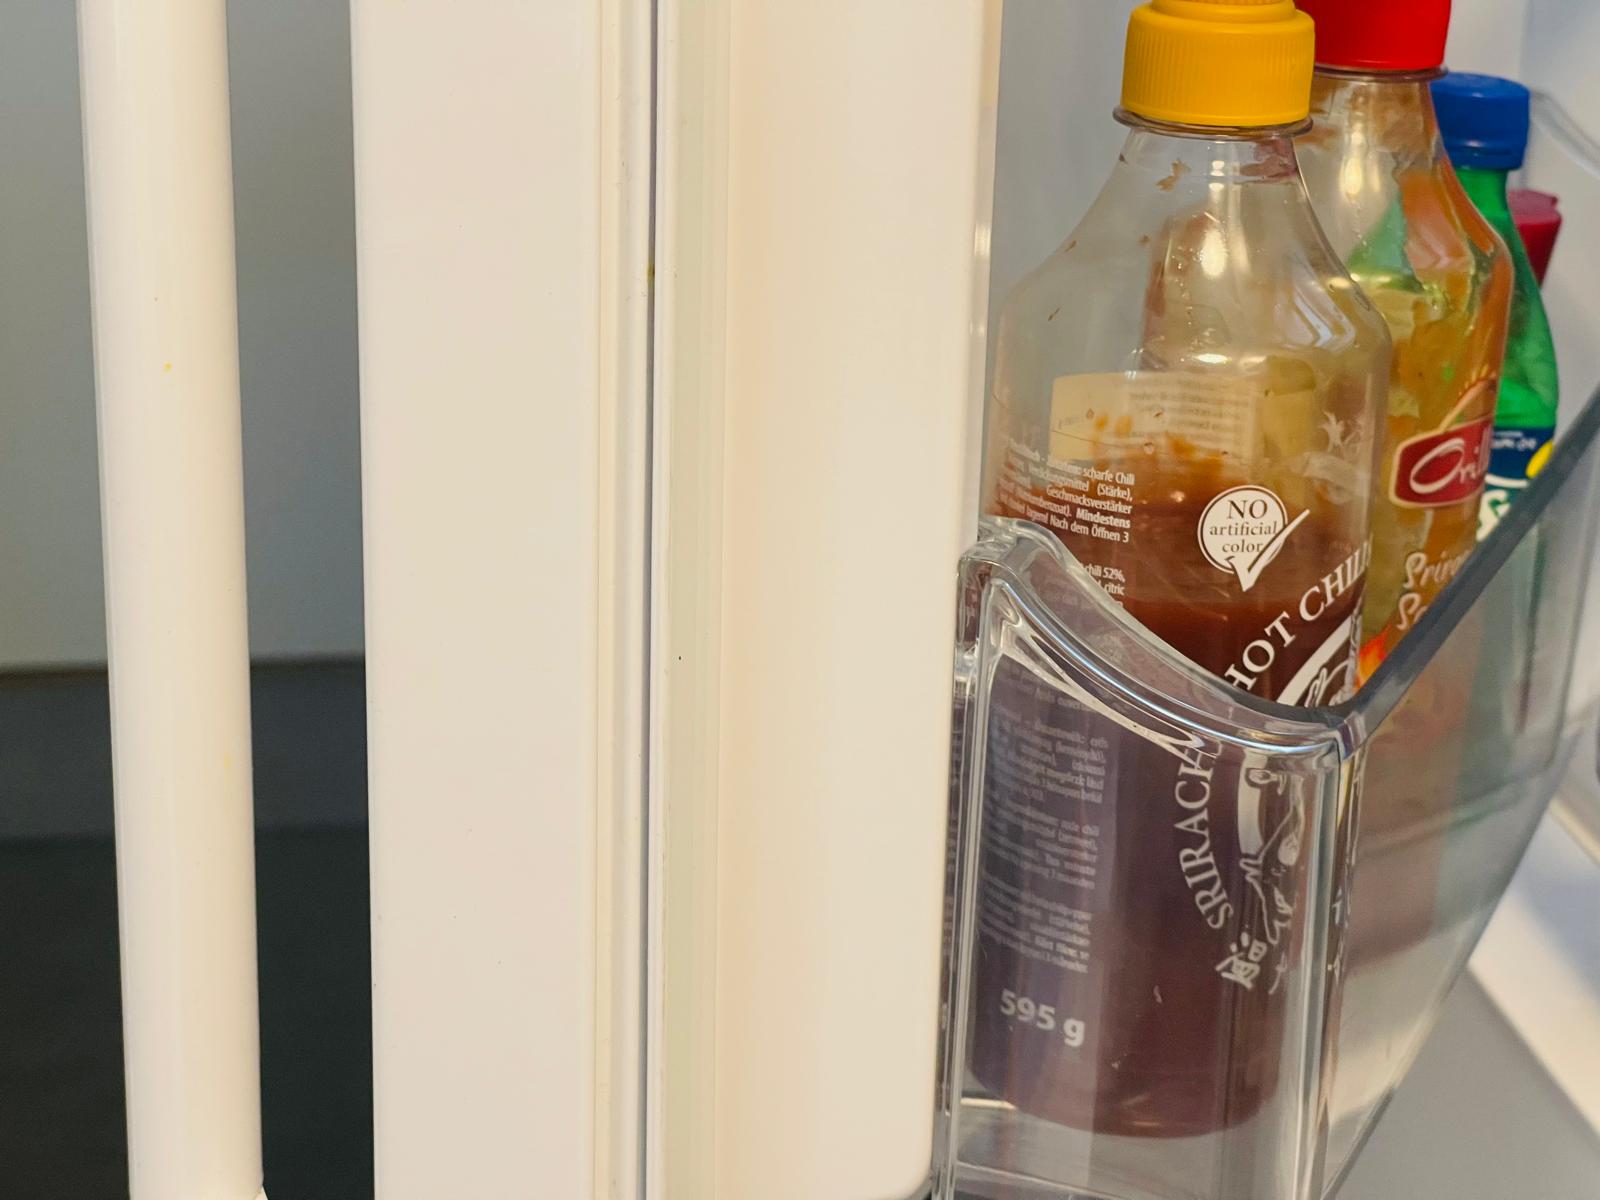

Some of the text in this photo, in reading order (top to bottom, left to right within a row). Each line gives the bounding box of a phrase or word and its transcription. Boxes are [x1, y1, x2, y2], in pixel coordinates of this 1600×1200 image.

[1083, 467, 1113, 482] scharfe
[1046, 485, 1133, 514] Geschmacksverstärker
[1097, 483, 1133, 502] (Stärke),
[1076, 507, 1131, 529] Mindestens
[1227, 499, 1268, 519] NO
[1050, 515, 1069, 530] Nach
[1070, 521, 1089, 535] dem
[1091, 524, 1120, 542] Öffnen
[1122, 531, 1130, 543] 3
[1209, 521, 1278, 536] artificial
[1222, 539, 1264, 553] color
[1224, 611, 1296, 692] HOT
[1000, 987, 1086, 1048] 595 g
